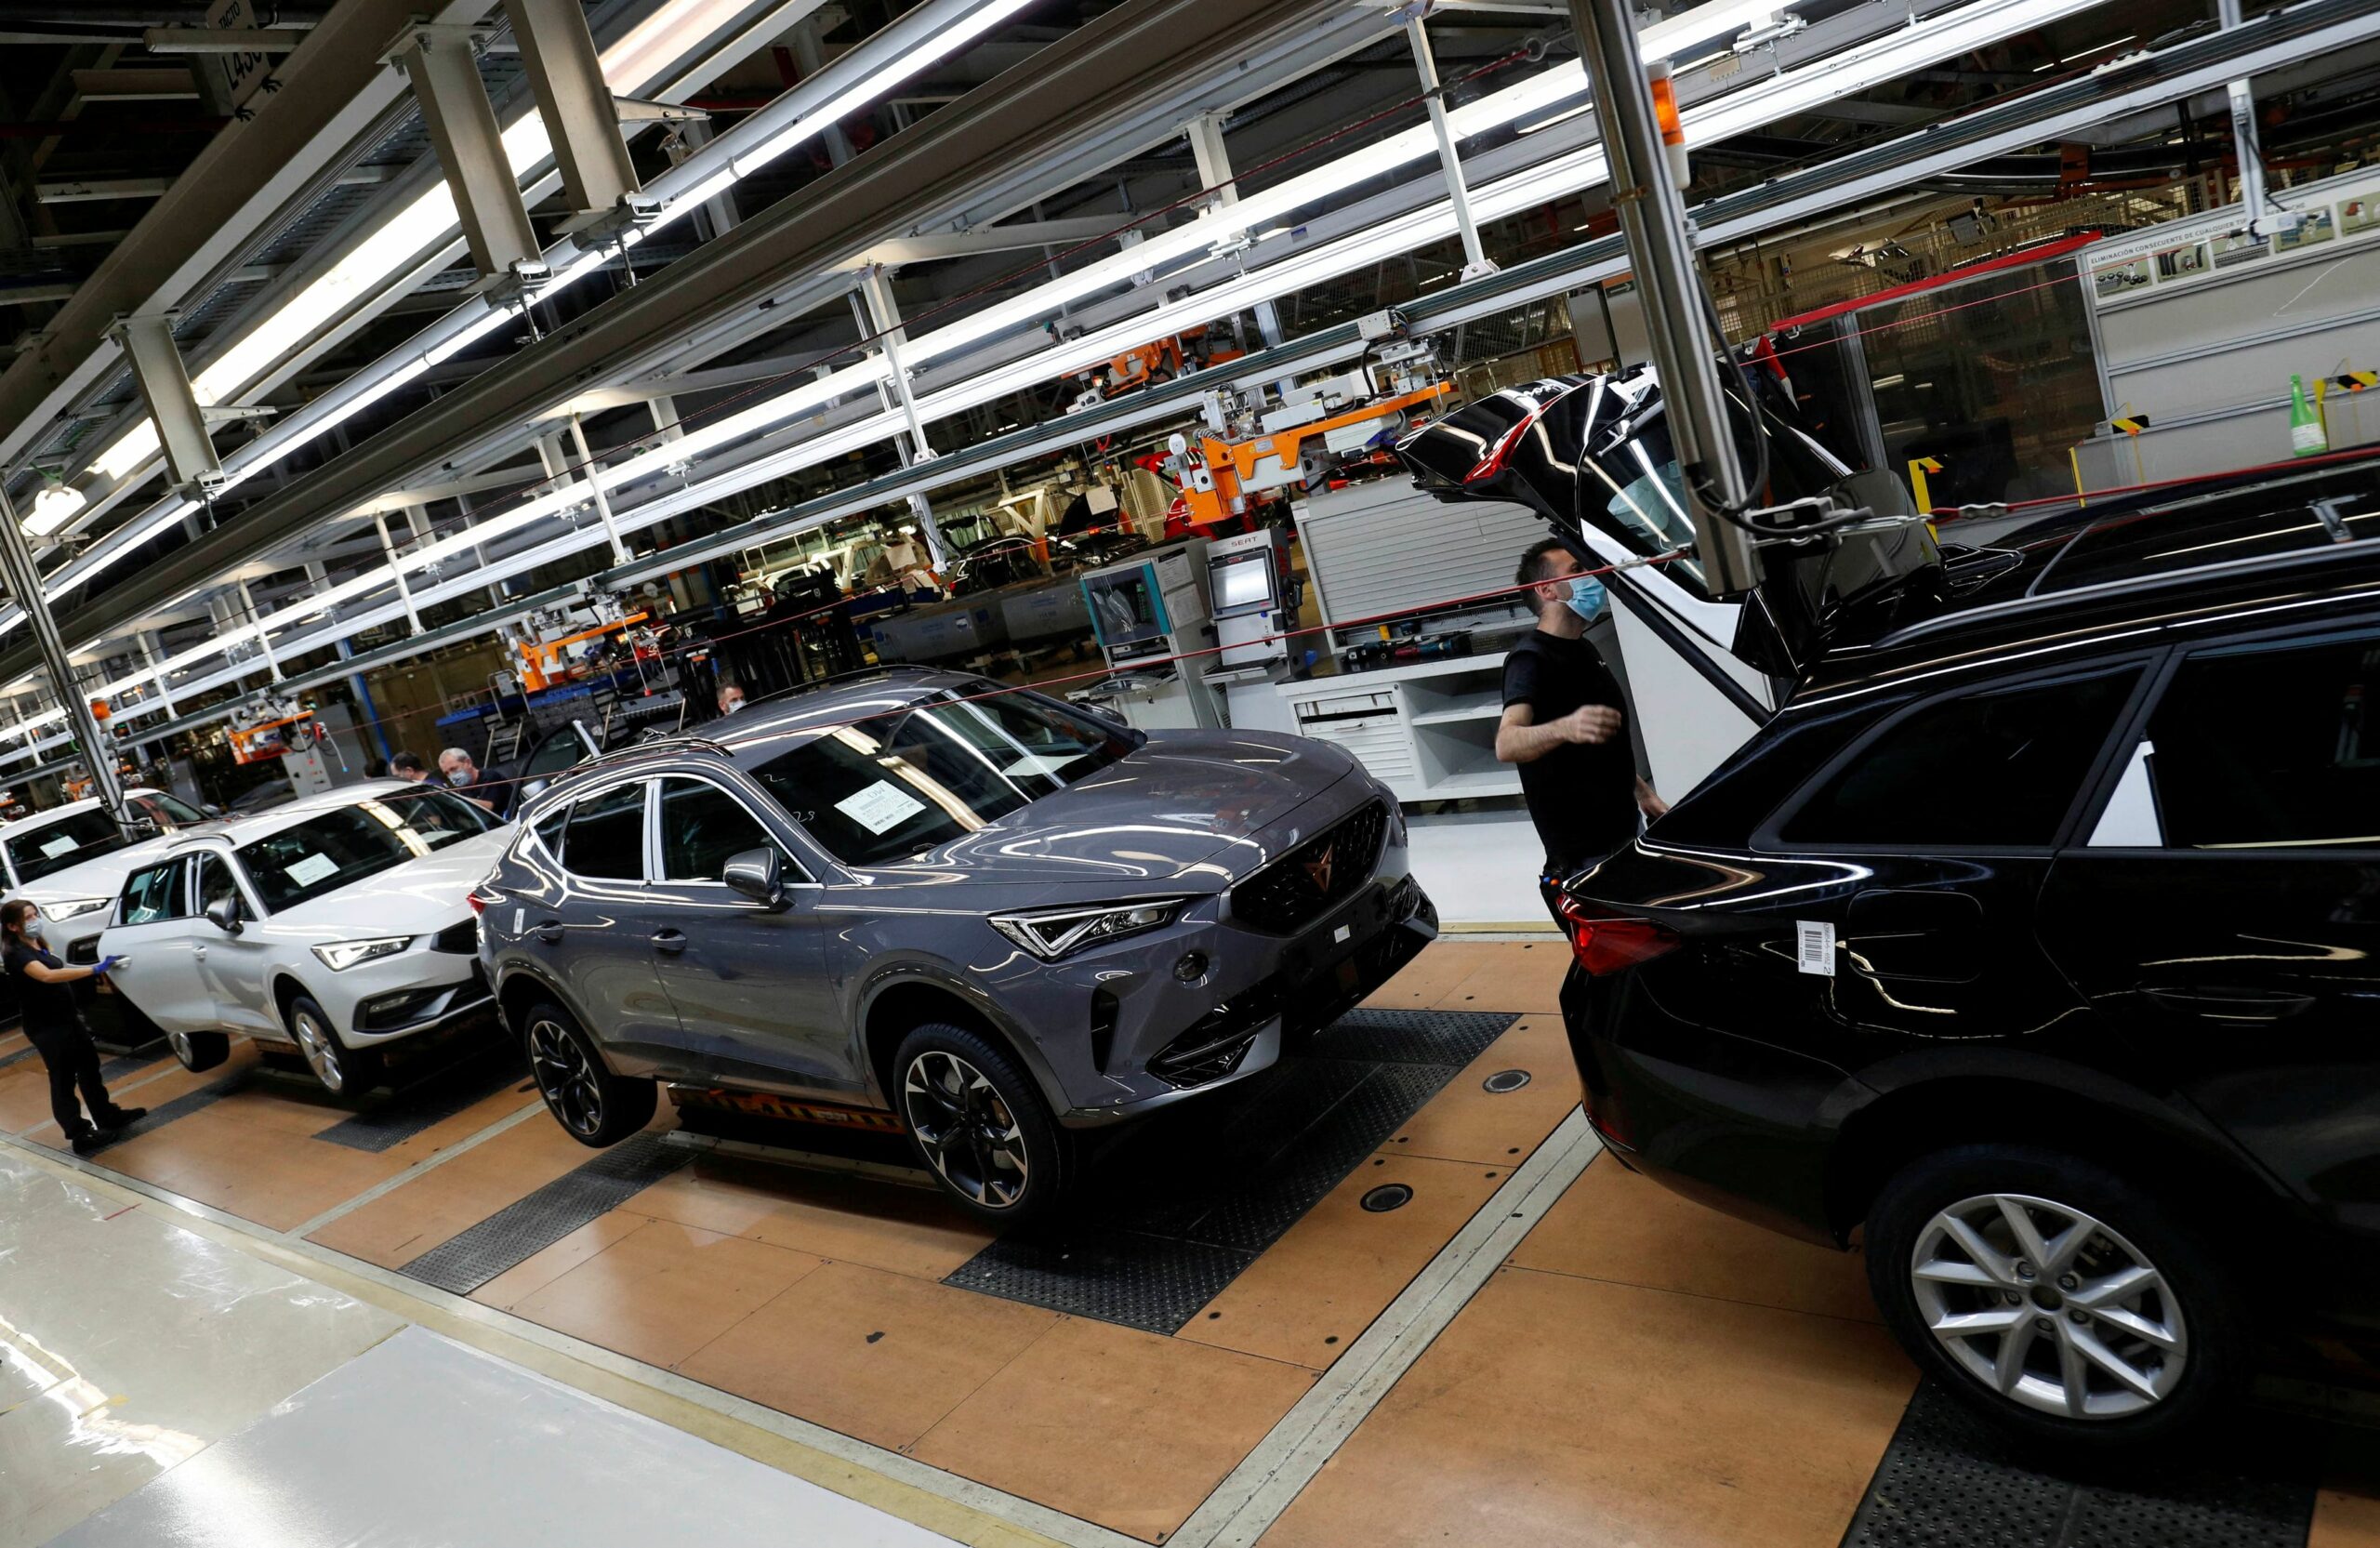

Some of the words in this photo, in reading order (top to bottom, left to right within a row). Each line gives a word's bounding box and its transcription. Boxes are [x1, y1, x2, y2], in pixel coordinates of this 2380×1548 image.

[2091, 248, 2134, 264] ELIMINACIÓN
[2135, 235, 2183, 252] CONSECUENTE
[1231, 536, 1258, 548] SEAT
